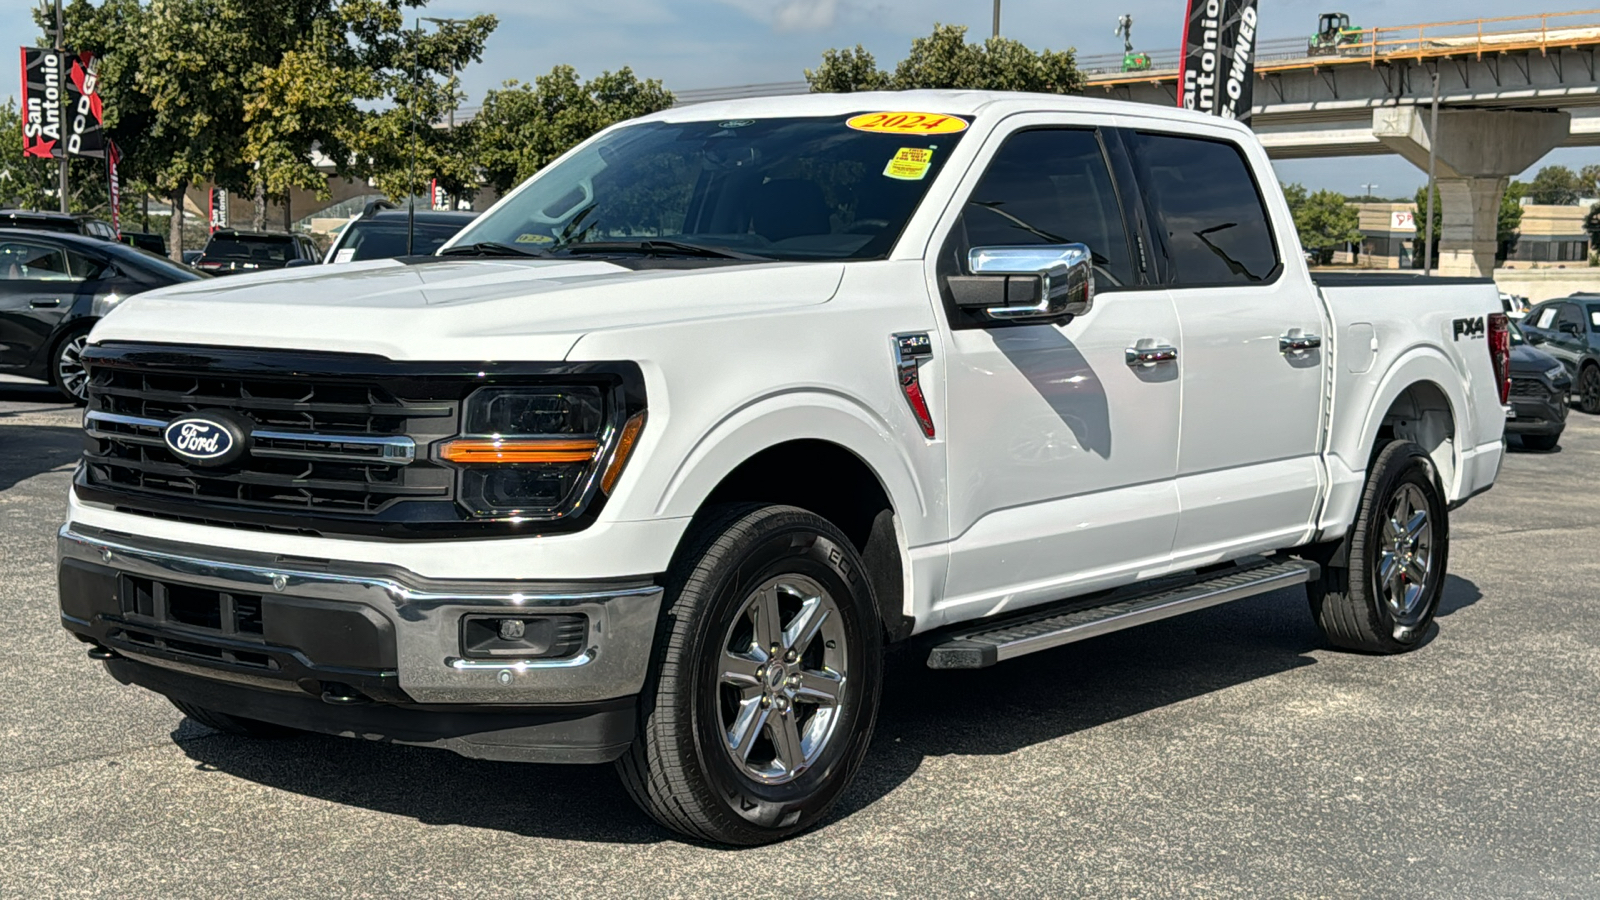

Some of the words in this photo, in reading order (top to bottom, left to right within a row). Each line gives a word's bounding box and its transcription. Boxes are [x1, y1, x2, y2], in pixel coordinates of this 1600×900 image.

[1197, 0, 1219, 116] ntonio
[40, 54, 60, 140] Antonio
[68, 55, 99, 154] DODGE
[1183, 70, 1196, 110] an
[24, 97, 42, 138] San
[860, 114, 949, 129] 2024
[210, 208, 219, 228] San
[218, 190, 226, 228] Antonio
[1452, 316, 1485, 342] FX4
[177, 423, 220, 452] Ford
